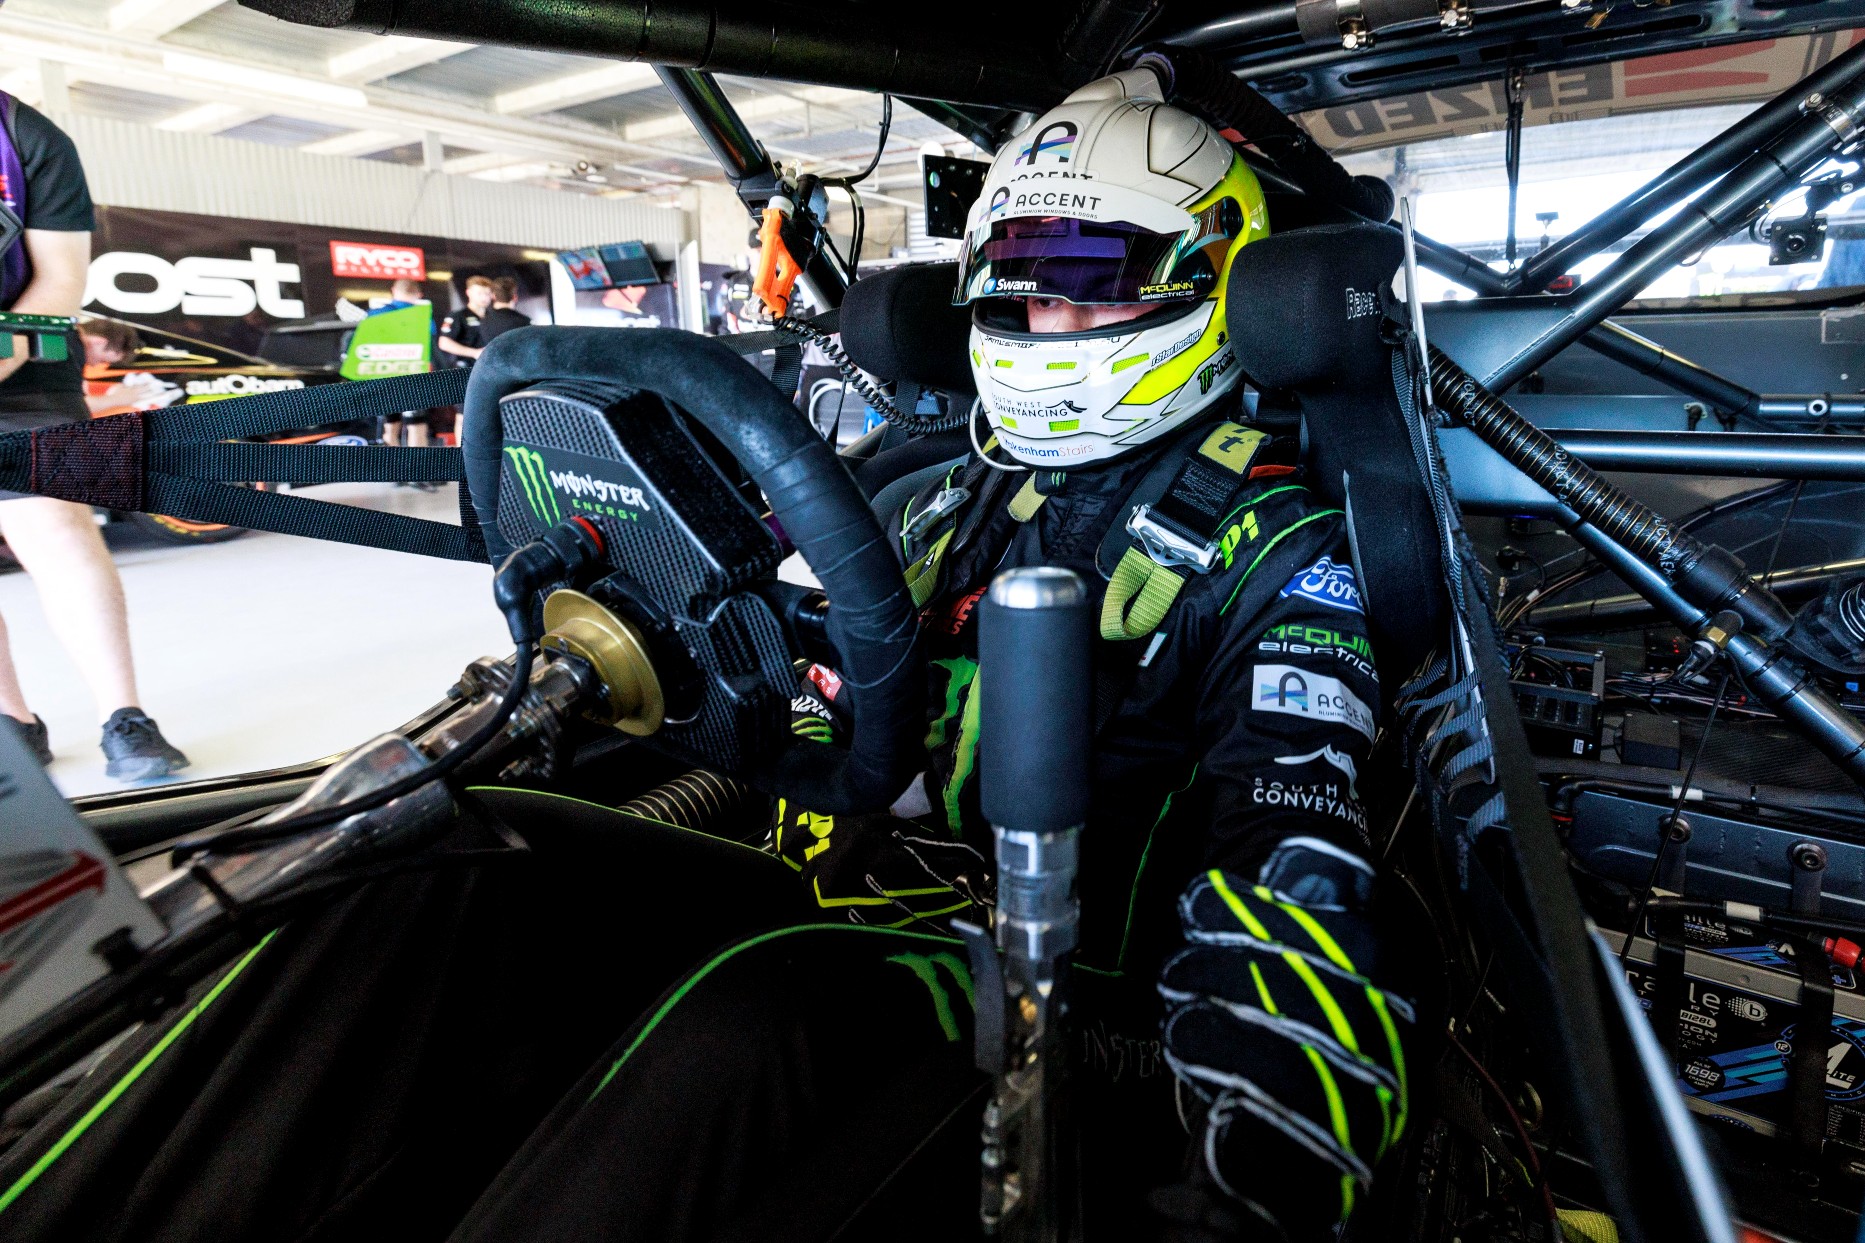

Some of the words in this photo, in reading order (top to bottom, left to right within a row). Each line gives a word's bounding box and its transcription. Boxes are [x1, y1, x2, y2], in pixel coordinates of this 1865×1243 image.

[1015, 192, 1102, 211] ACCENT
[334, 245, 420, 269] RYCO
[995, 278, 1038, 291] Swann
[1141, 289, 1195, 300] electrical
[1016, 400, 1041, 409] WEST
[549, 470, 651, 511] MONSTER
[572, 498, 639, 521] ENERGY
[1254, 777, 1338, 799] SOUTH
[1684, 1064, 1720, 1082] 1698
